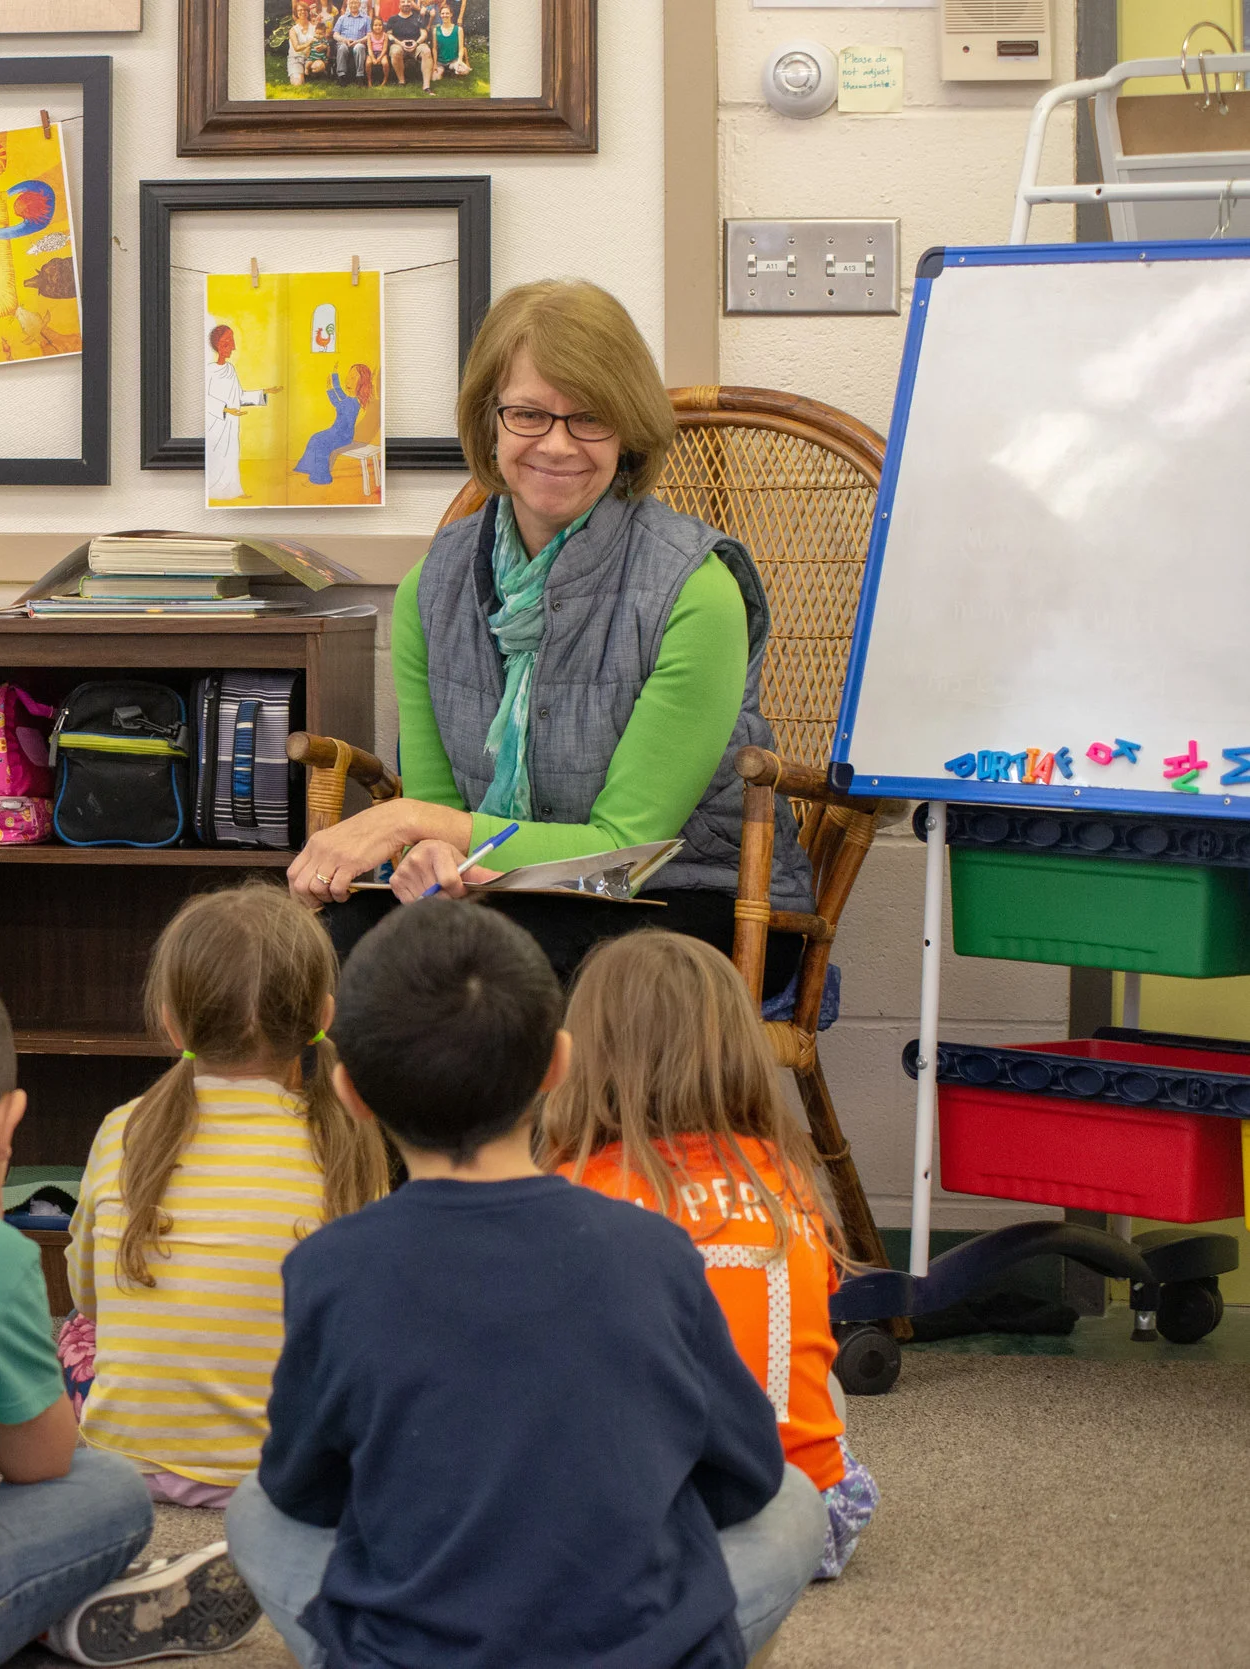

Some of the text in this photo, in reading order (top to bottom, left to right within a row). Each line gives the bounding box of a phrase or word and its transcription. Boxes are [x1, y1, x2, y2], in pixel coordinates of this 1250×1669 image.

[844, 53, 886, 63] Please do
[842, 66, 891, 78] not adjust
